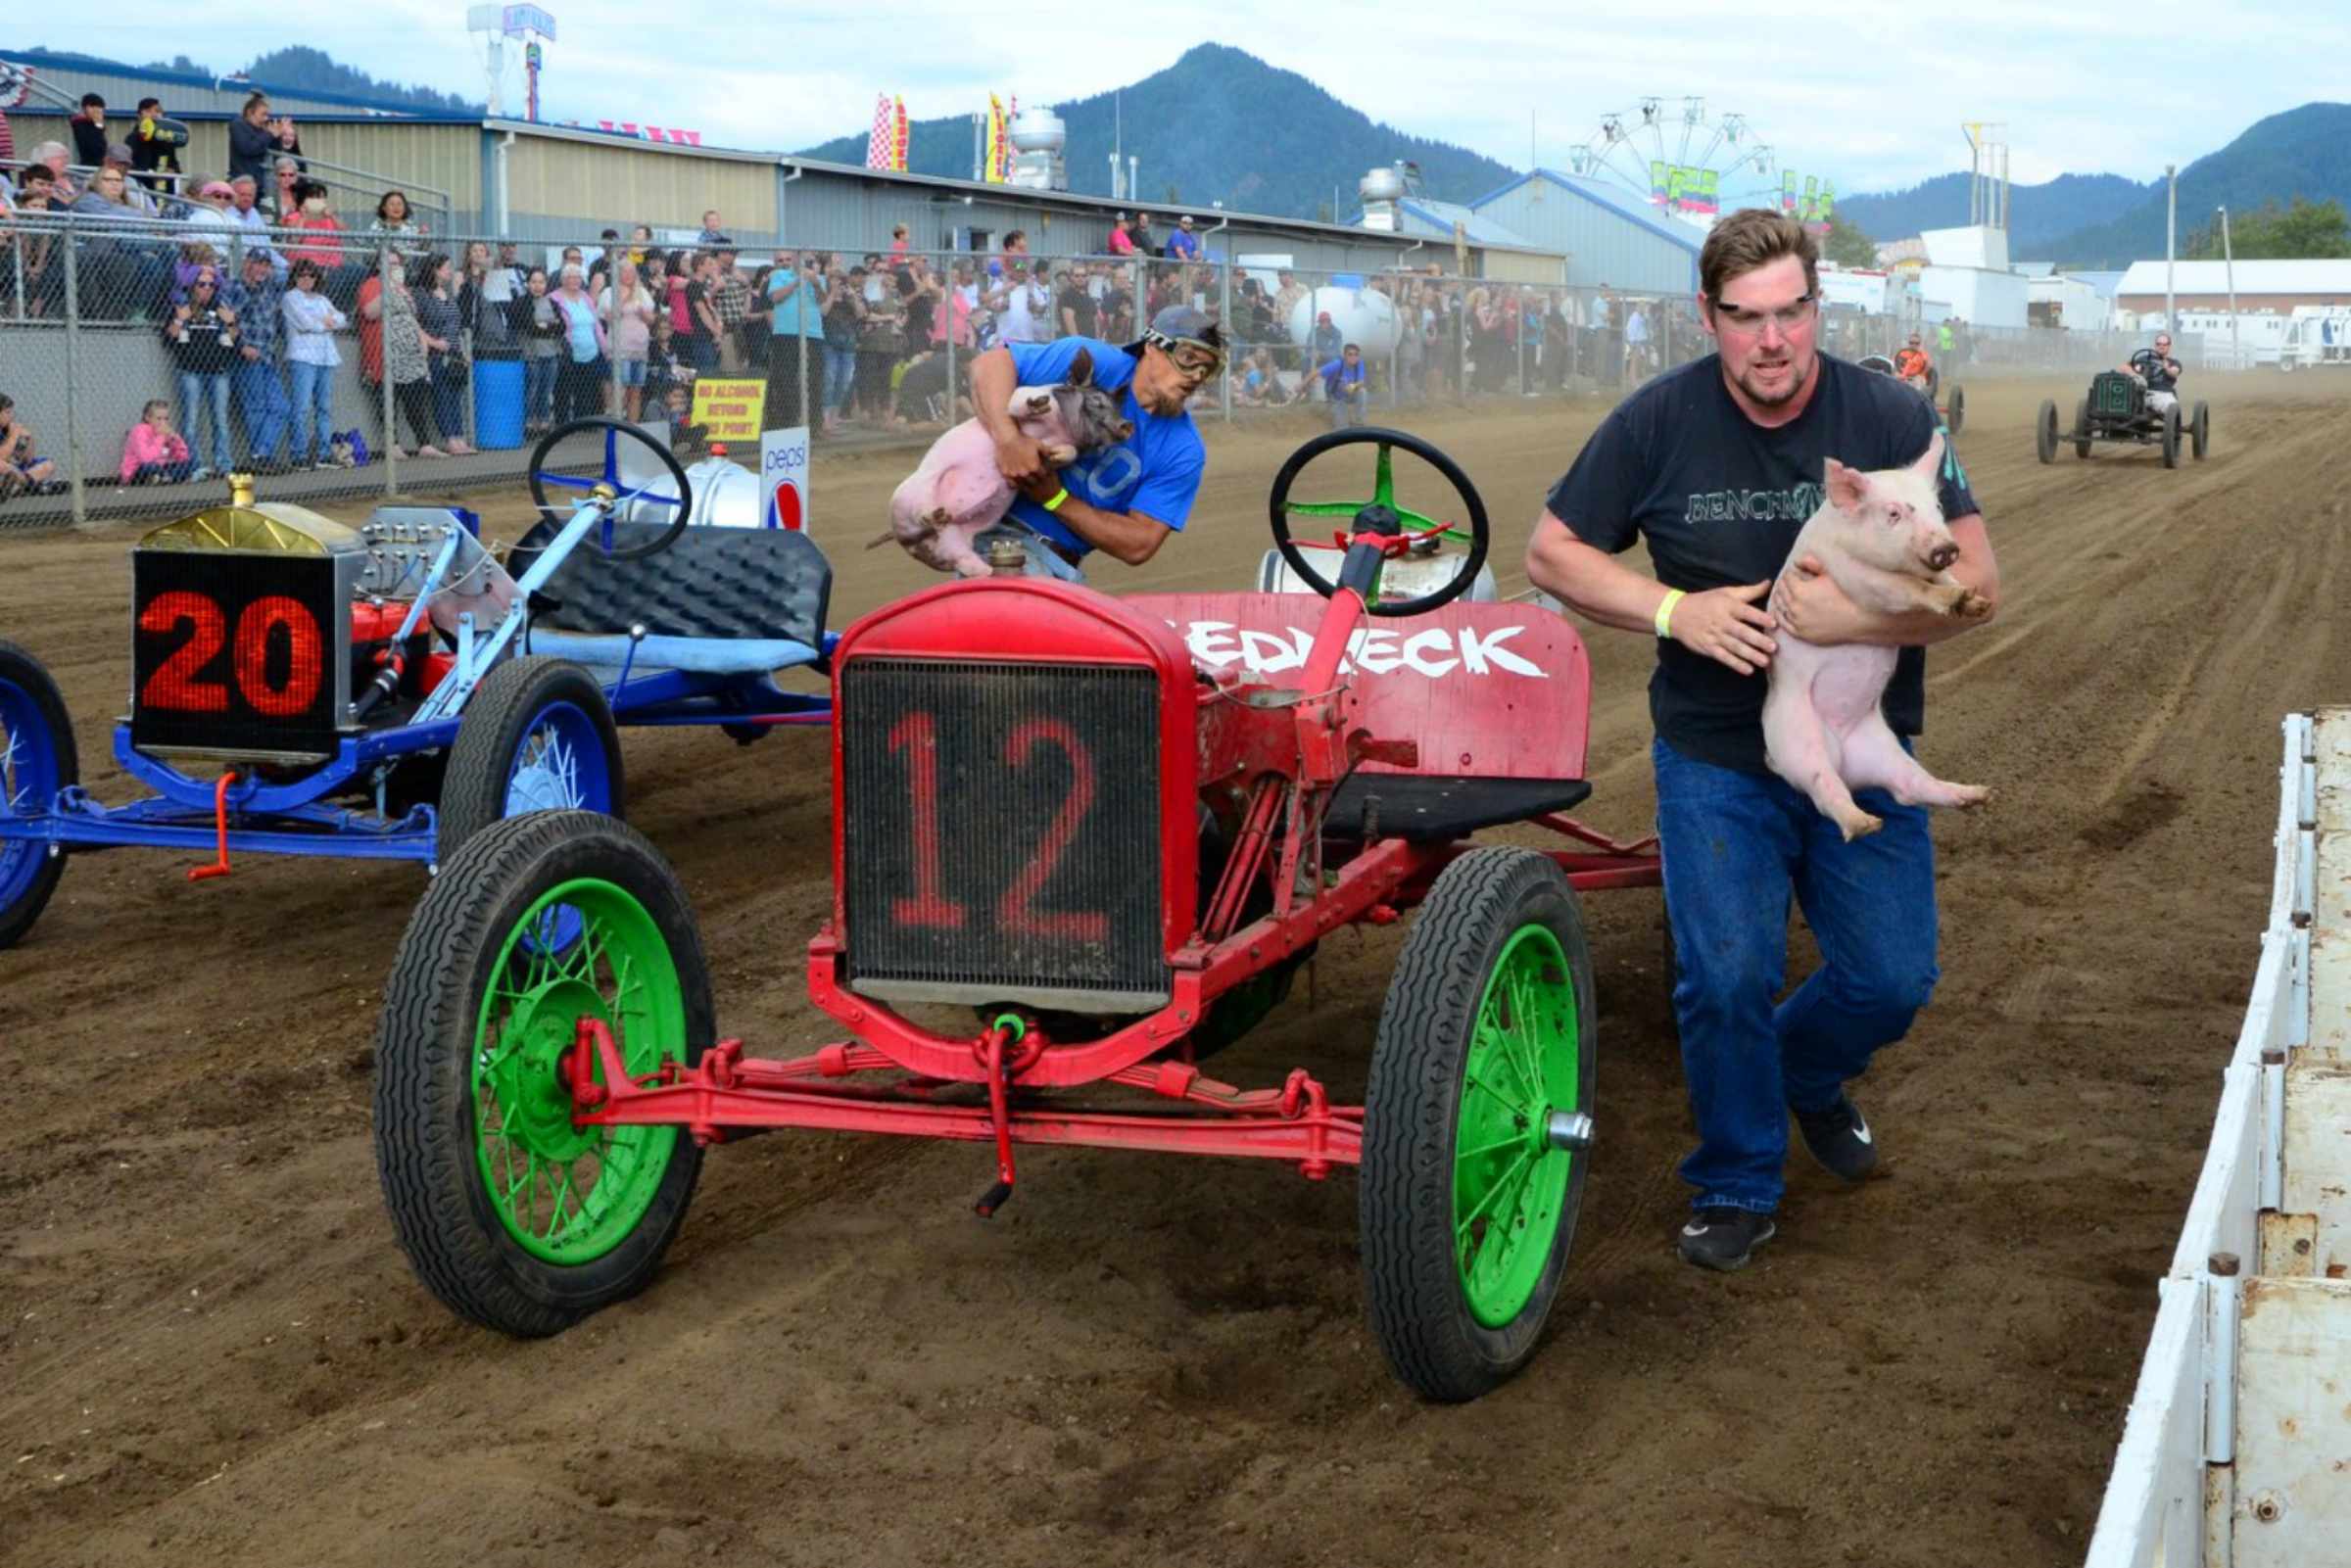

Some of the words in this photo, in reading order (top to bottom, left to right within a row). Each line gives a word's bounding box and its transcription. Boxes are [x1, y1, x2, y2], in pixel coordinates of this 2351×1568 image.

[698, 385, 711, 398] NO
[716, 385, 760, 399] ALCOHOL
[707, 403, 747, 416] BEYOND
[724, 422, 753, 435] POINT
[766, 440, 805, 475] pepsi
[139, 591, 323, 718] 20
[1163, 619, 1550, 679] EDECK
[888, 711, 1110, 940] 12
